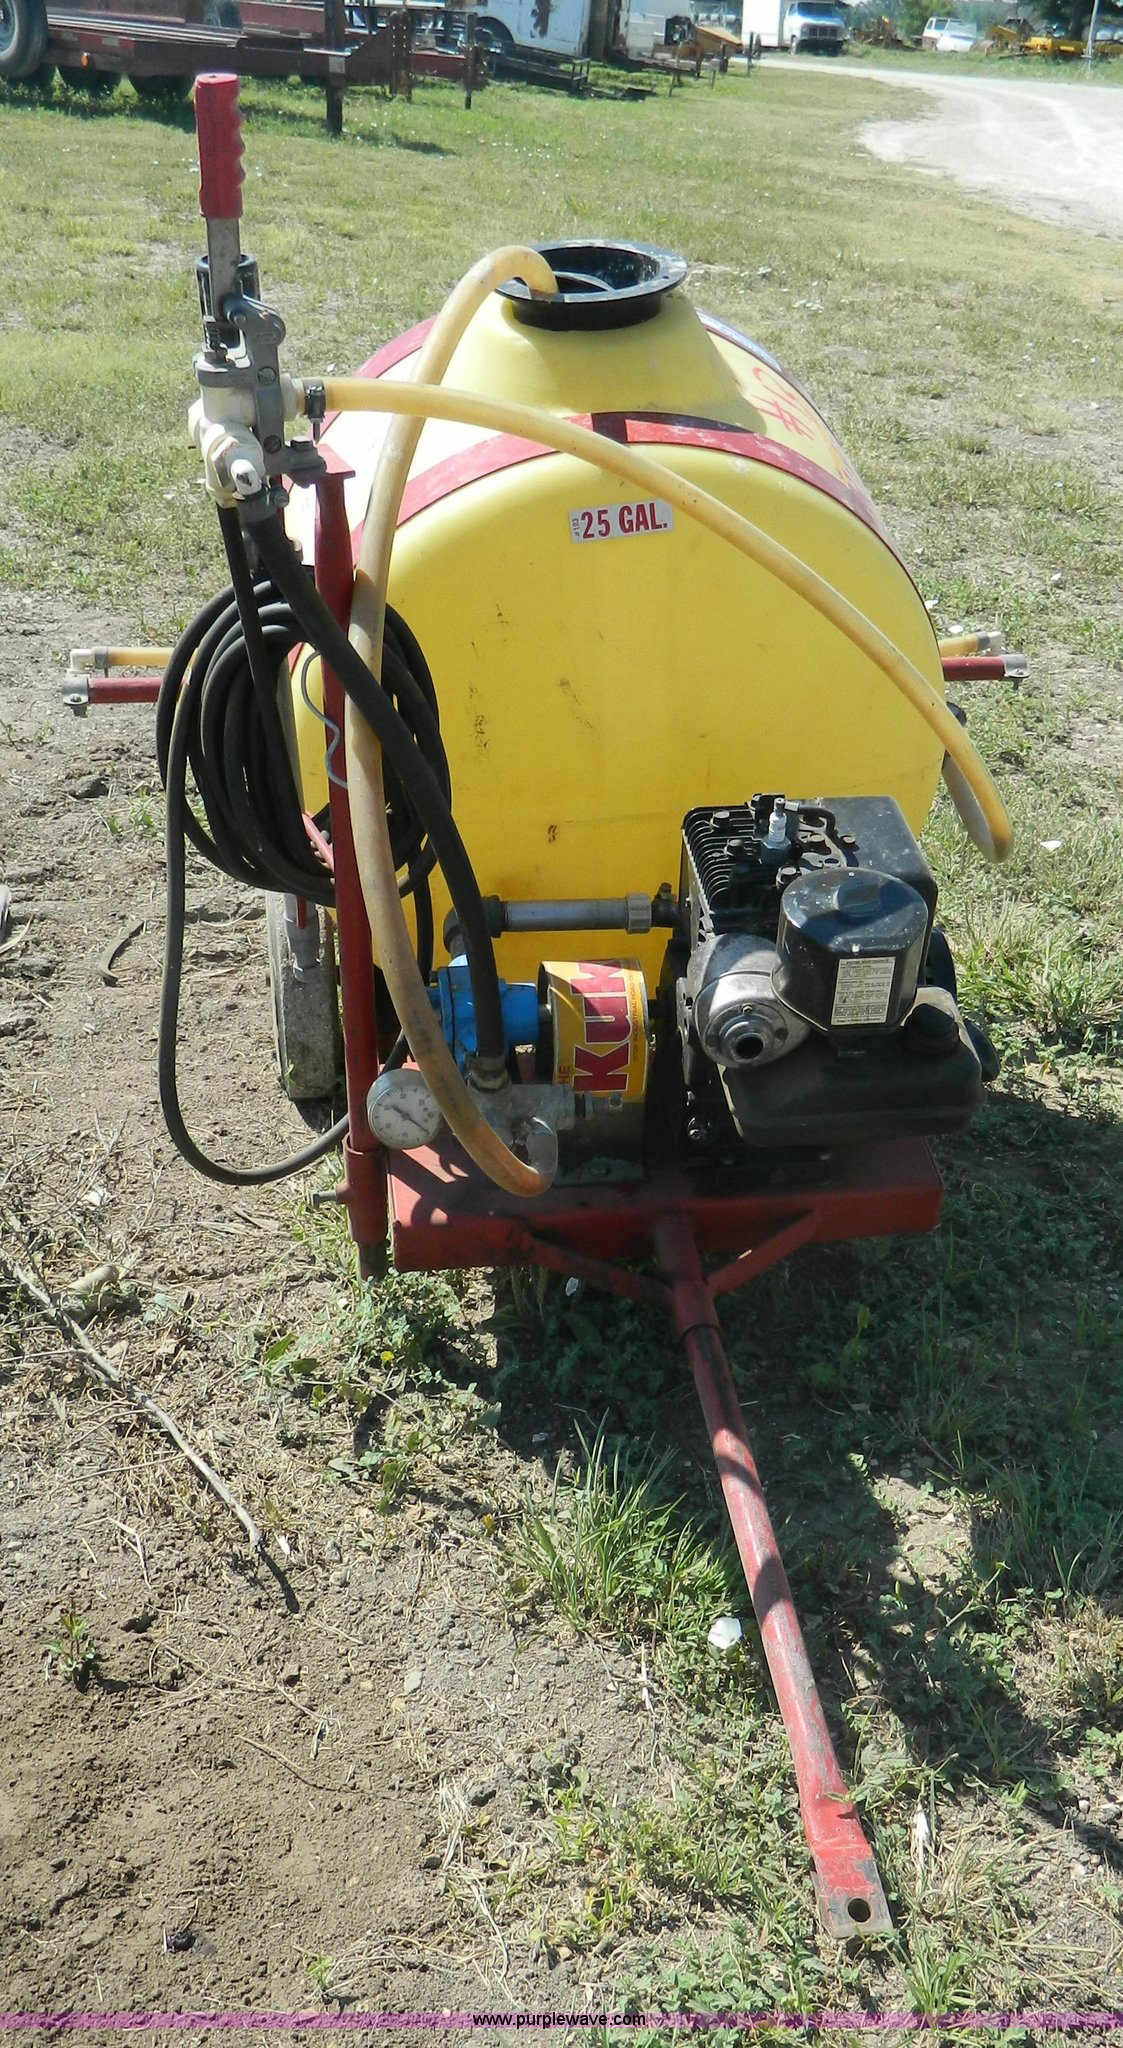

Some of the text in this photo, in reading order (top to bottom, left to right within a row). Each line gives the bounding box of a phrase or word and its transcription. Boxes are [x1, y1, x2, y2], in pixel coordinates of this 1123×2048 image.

[580, 502, 668, 539] 25 GAL.
[558, 1065, 570, 1084] HE
